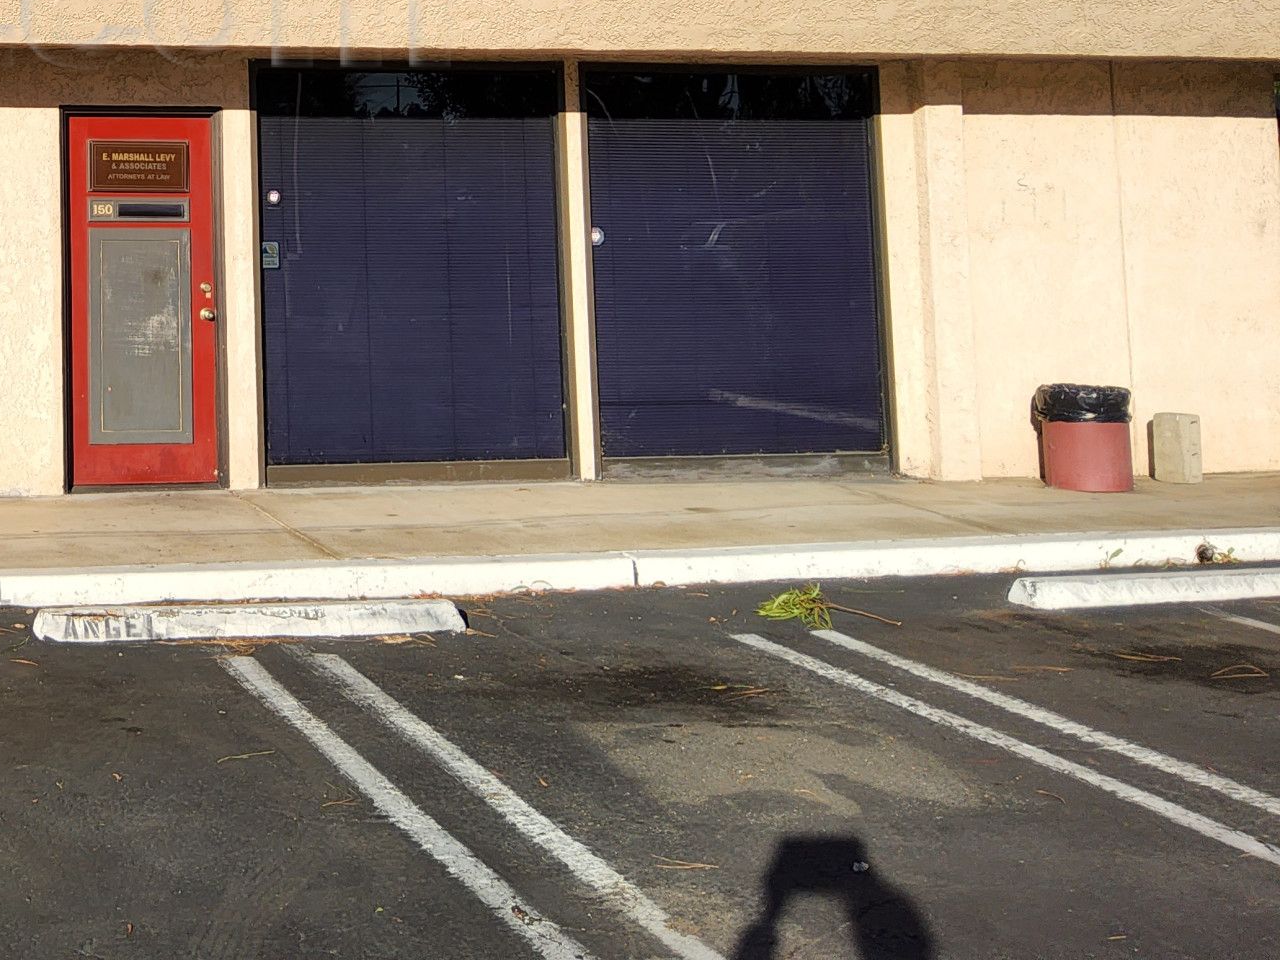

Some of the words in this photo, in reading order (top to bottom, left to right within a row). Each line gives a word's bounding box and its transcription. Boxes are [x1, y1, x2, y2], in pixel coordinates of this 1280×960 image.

[102, 152, 111, 161] E.
[111, 152, 154, 161] MARSHALL
[155, 153, 176, 162] LEVY
[119, 162, 167, 170] ASSOCIATES
